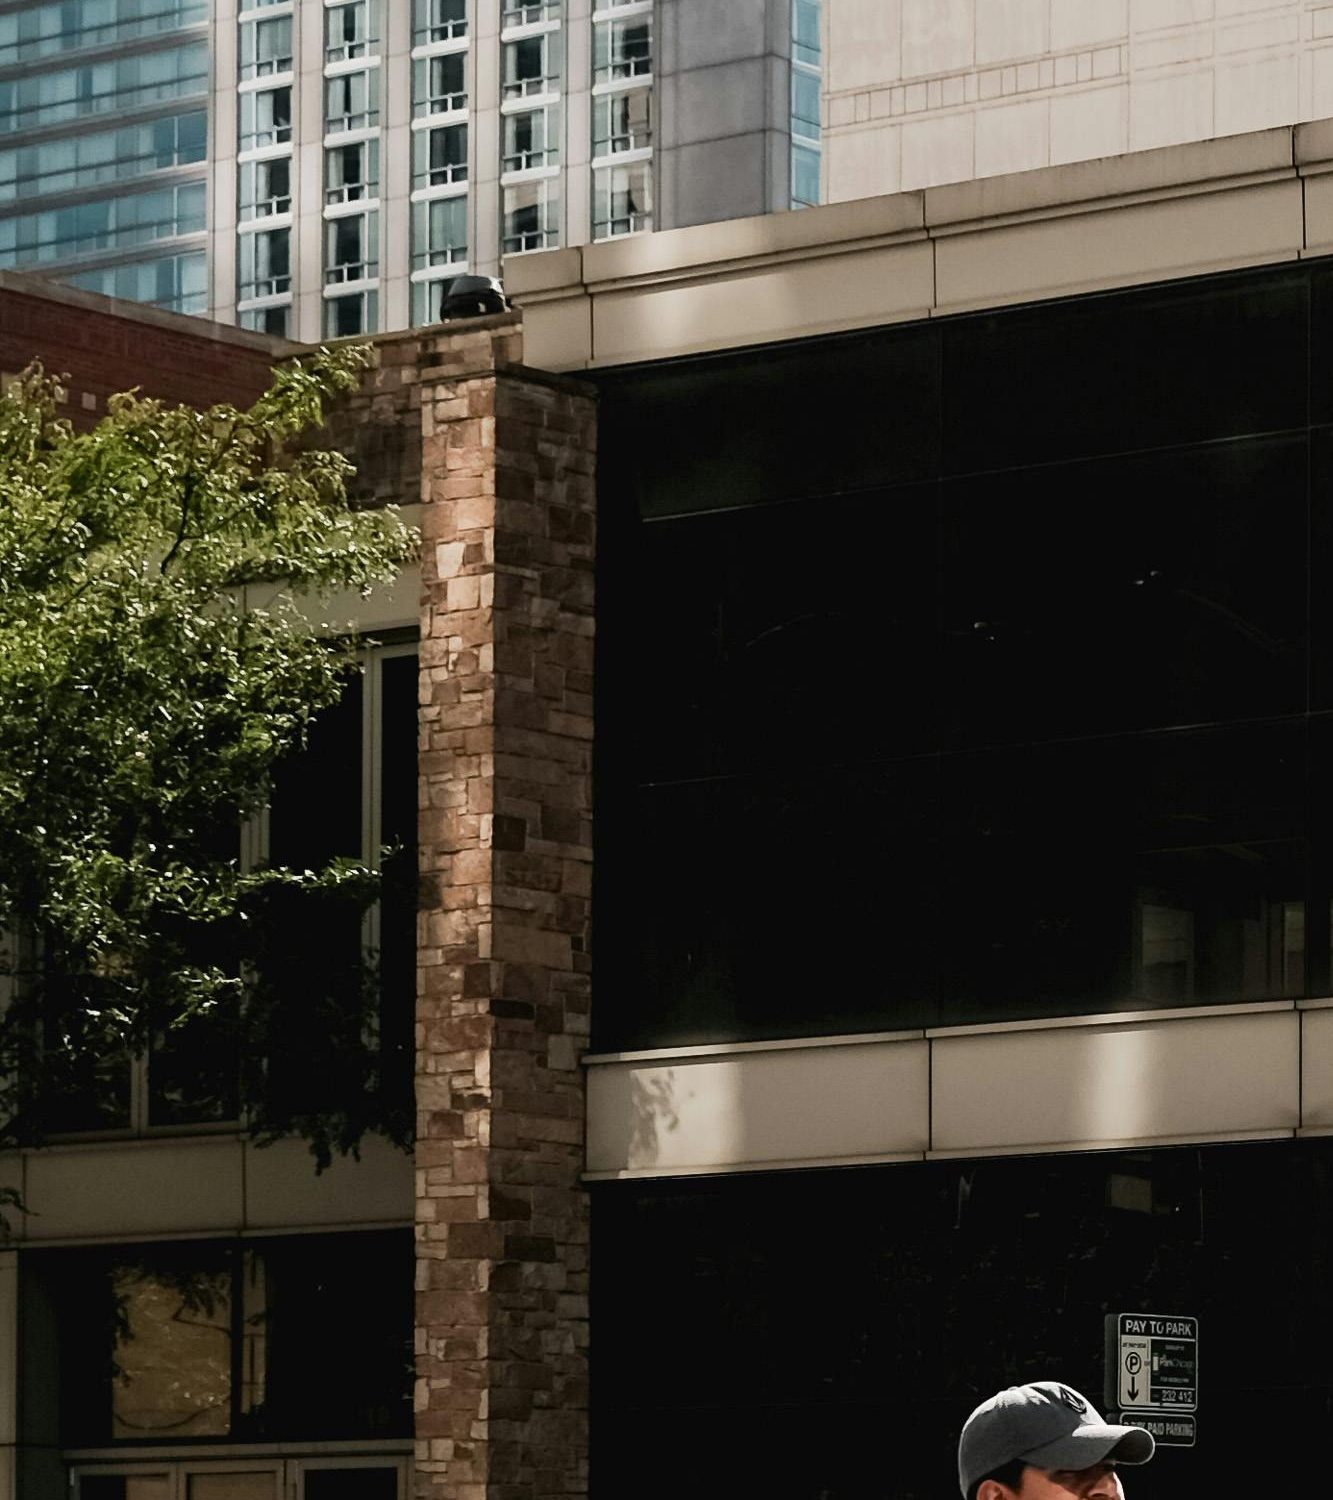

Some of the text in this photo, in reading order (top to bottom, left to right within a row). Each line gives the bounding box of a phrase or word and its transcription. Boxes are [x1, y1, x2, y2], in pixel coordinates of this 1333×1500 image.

[1125, 1319, 1192, 1337] PAY TO PARK
[1147, 1422, 1165, 1436] PAID
[1165, 1423, 1194, 1437] PARKING
